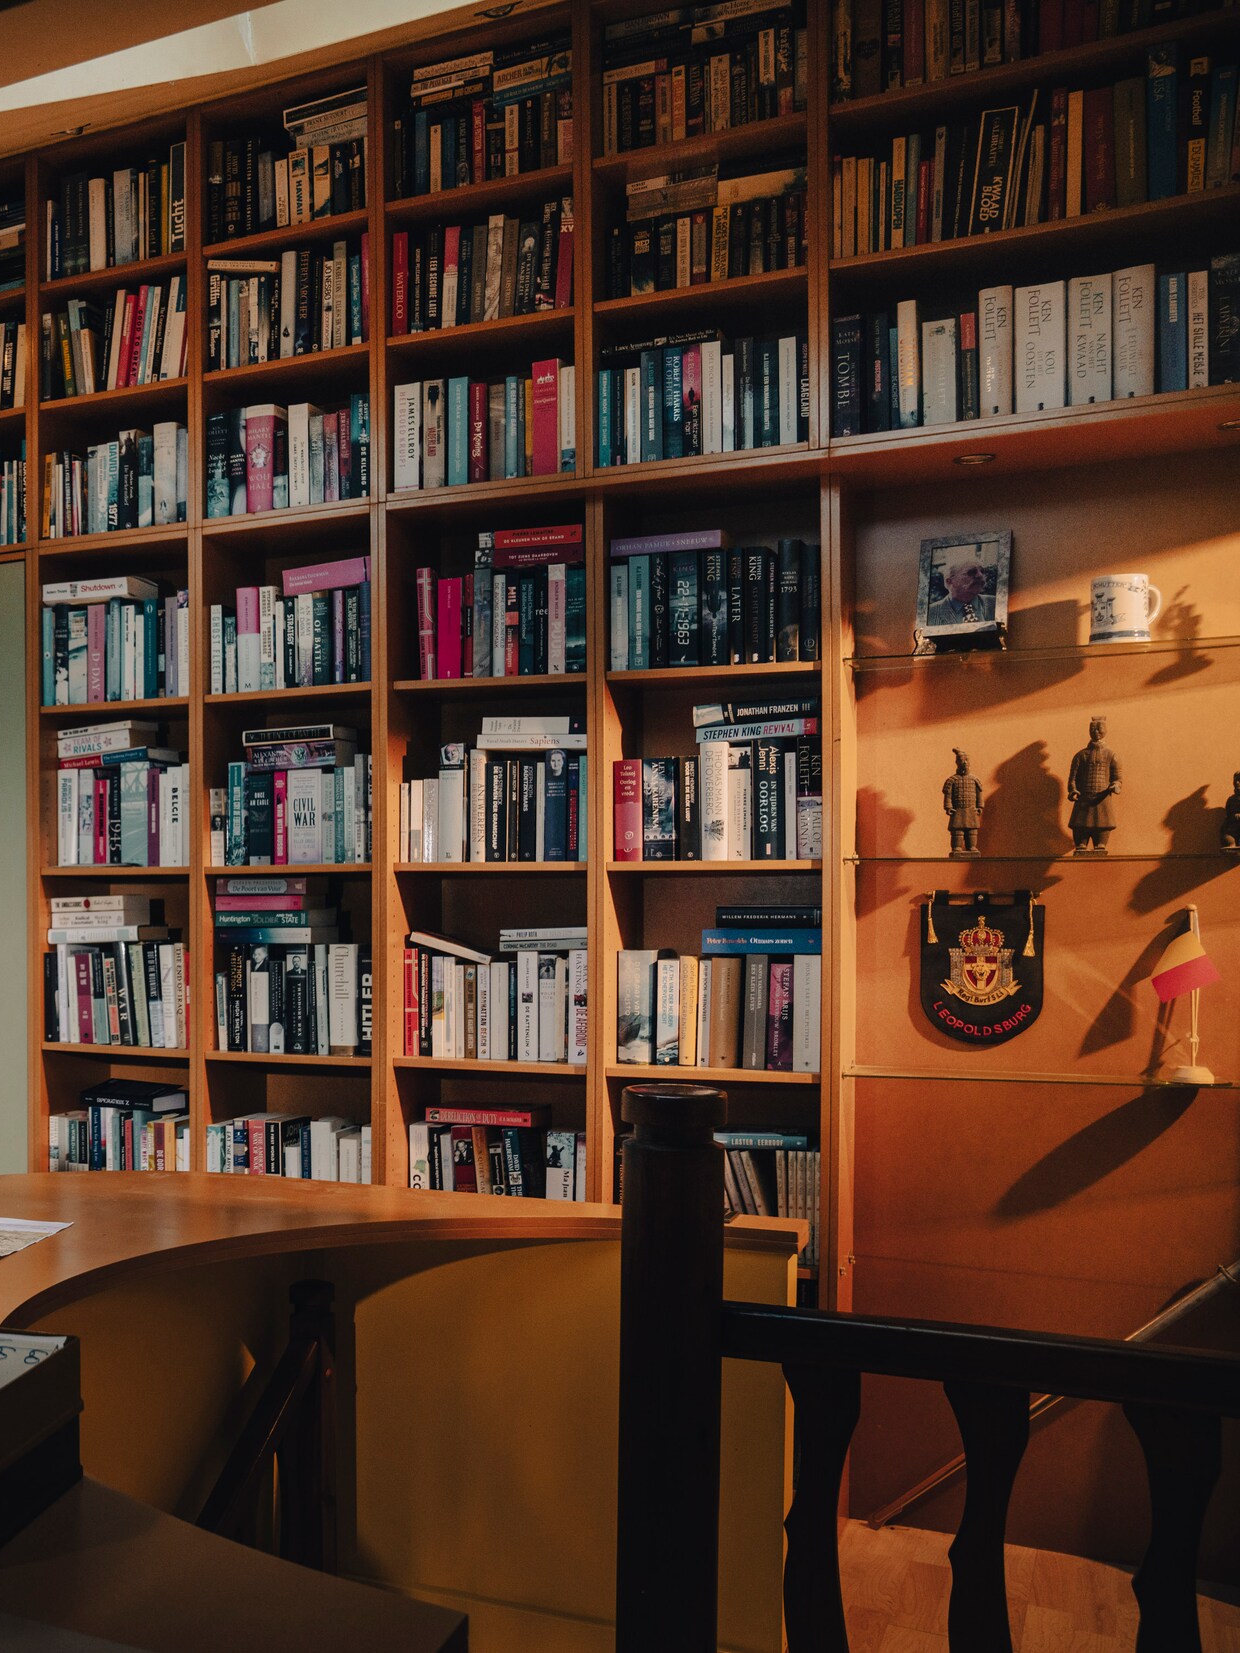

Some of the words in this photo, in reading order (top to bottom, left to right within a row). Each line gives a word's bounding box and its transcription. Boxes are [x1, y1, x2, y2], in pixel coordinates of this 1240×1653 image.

[496, 68, 522, 84] ARCHER
[295, 180, 303, 216] HAWAII
[892, 179, 904, 229] HARDLOPEN
[979, 186, 993, 221] BLOED
[989, 176, 1003, 218] KWAAD
[171, 199, 185, 243] Tucht
[300, 251, 310, 282] JEFFREY
[299, 284, 309, 319] ARCHER
[396, 272, 404, 319] WATERLOO
[1079, 282, 1092, 329] FOLLETT
[1093, 293, 1103, 315] KEN
[1119, 276, 1131, 324] FOLLETT
[1133, 287, 1143, 309] KEN
[135, 309, 144, 332] GOOD
[985, 296, 996, 341] FOLLETT
[997, 306, 1007, 328] KEN
[1028, 290, 1040, 336] FOLLETT
[1041, 300, 1051, 323] KEN
[1193, 313, 1204, 326] HET
[135, 336, 141, 346] TO
[1192, 328, 1203, 350] STILLE
[131, 351, 139, 377] GREAT
[665, 357, 672, 367] DE
[1026, 342, 1036, 389] OOSTEN
[1045, 350, 1055, 375] KOU
[1076, 334, 1087, 379] KWAAD
[1096, 333, 1106, 376] NACHT
[1119, 344, 1127, 371] VUUR
[1192, 352, 1203, 376] MEISJE
[673, 356, 681, 388] ROBERT
[837, 352, 849, 410] TOMBE
[407, 398, 415, 425] JAMES
[673, 391, 681, 422] HARRIS
[801, 379, 810, 418] LAAGLAND
[247, 433, 272, 441] MANTEL
[473, 422, 482, 432] De
[361, 447, 367, 456] DE
[407, 428, 415, 460] ELLROY
[427, 427, 436, 457] VADERLAND
[471, 433, 482, 458] Koning
[109, 444, 118, 473] DAVID
[109, 474, 117, 503] PEACE
[248, 473, 271, 482] WOLF
[249, 482, 271, 491] HALL
[108, 503, 118, 527] 1977
[615, 543, 642, 551] ORHAN
[643, 540, 670, 549] PAMUK
[675, 537, 707, 545] SNEEUW
[706, 556, 714, 582] KING
[748, 556, 757, 581] KING
[80, 582, 116, 593] Shutdown
[677, 580, 689, 646] 22-11-1963
[731, 586, 741, 623] LATER
[213, 616, 221, 645] GHOST
[314, 620, 322, 634] OF
[551, 621, 562, 658] PUUR
[213, 649, 221, 676] FLEET
[314, 638, 322, 673] BATTLE
[92, 653, 101, 692] D-DAY
[736, 706, 768, 717] JONATHAN
[768, 704, 798, 714] FRANZEN
[529, 737, 560, 746] Sapiens
[703, 728, 739, 740] STEPHEN
[740, 726, 761, 736] KING
[763, 723, 795, 734] REVIVAL
[73, 743, 102, 754] RIVALS
[705, 750, 713, 761] DE
[758, 746, 769, 771] Jenni
[768, 746, 780, 774] Alexis
[63, 760, 84, 769] Michael
[85, 758, 99, 766] Lewis
[714, 750, 722, 787] THOMAS
[799, 746, 810, 786] FOLLETT
[811, 755, 821, 776] KEN
[705, 762, 713, 816] TOVERBERG
[770, 781, 777, 789] IN
[293, 797, 315, 812] CIVIL
[714, 789, 722, 815] MANN
[759, 781, 769, 832] OORLOG
[293, 813, 315, 827] WAR
[110, 819, 121, 852] 1945
[218, 916, 251, 925] Huntington
[281, 916, 299, 924] STATE
[335, 946, 350, 1000] Churchill
[782, 967, 790, 997] STEFAN
[176, 983, 183, 993] OF
[118, 987, 128, 1021] WAR
[361, 973, 372, 1041] HITLER
[525, 1006, 530, 1014] DE
[782, 999, 790, 1020] BRIJS
[933, 1001, 1032, 1036] LEOPOLDSBURG
[440, 1110, 475, 1122] DERELICTION
[475, 1112, 481, 1120] OF
[482, 1112, 497, 1124] DUTY
